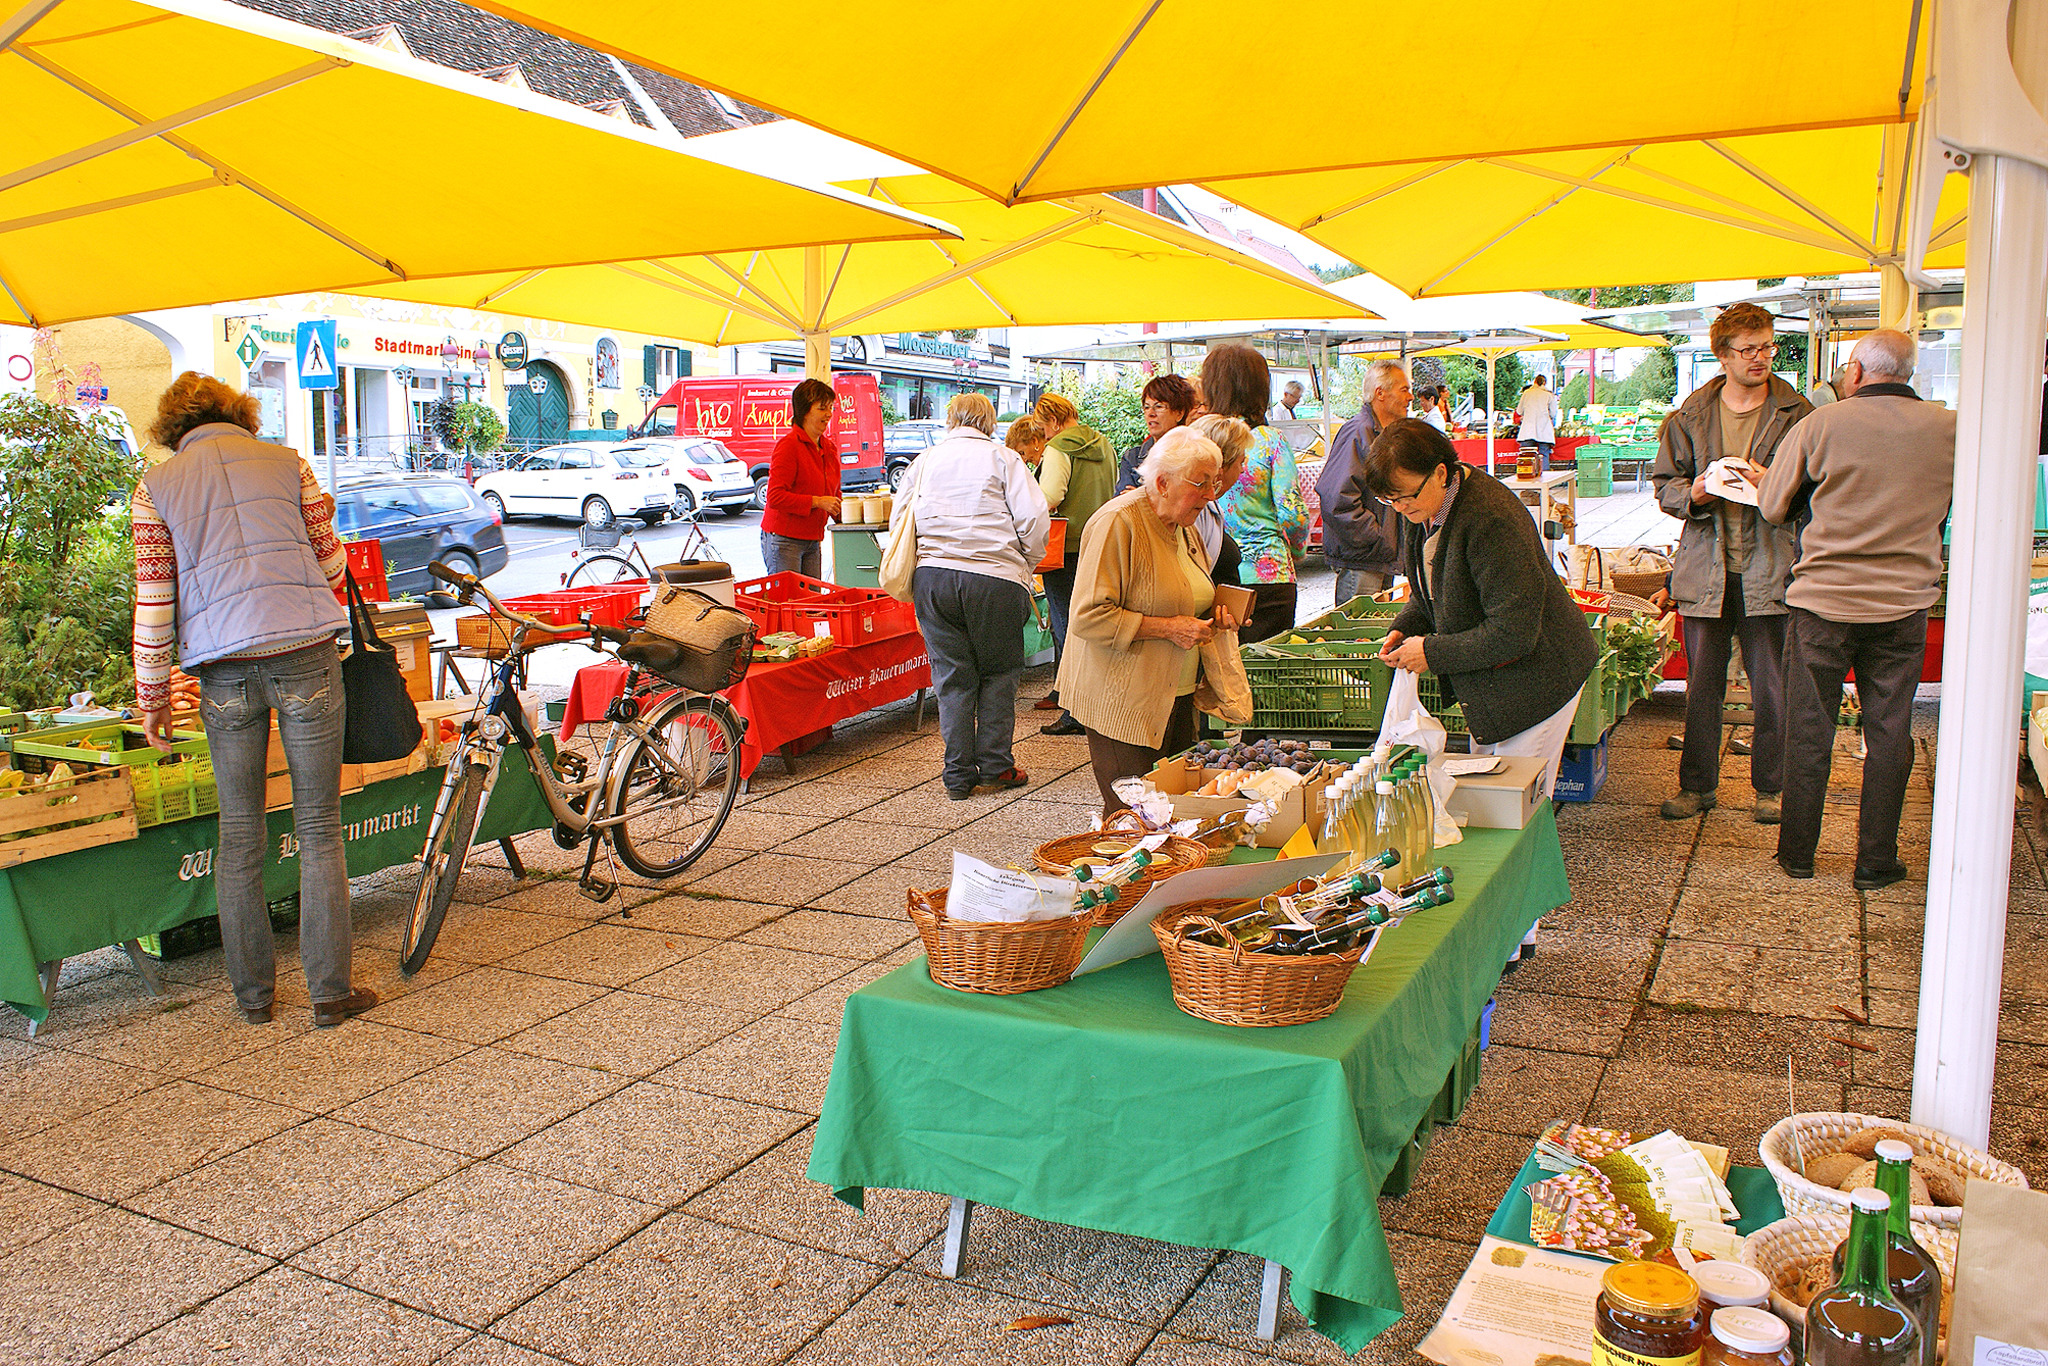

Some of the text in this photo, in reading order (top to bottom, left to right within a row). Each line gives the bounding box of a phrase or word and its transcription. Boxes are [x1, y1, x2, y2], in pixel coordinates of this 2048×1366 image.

[899, 332, 971, 358] Moosbauer
[838, 393, 854, 412] bio
[695, 397, 731, 435] bio
[826, 676, 864, 699] Weizer
[1554, 779, 1585, 793] tephan
[1533, 1262, 1594, 1279] DINKEL
